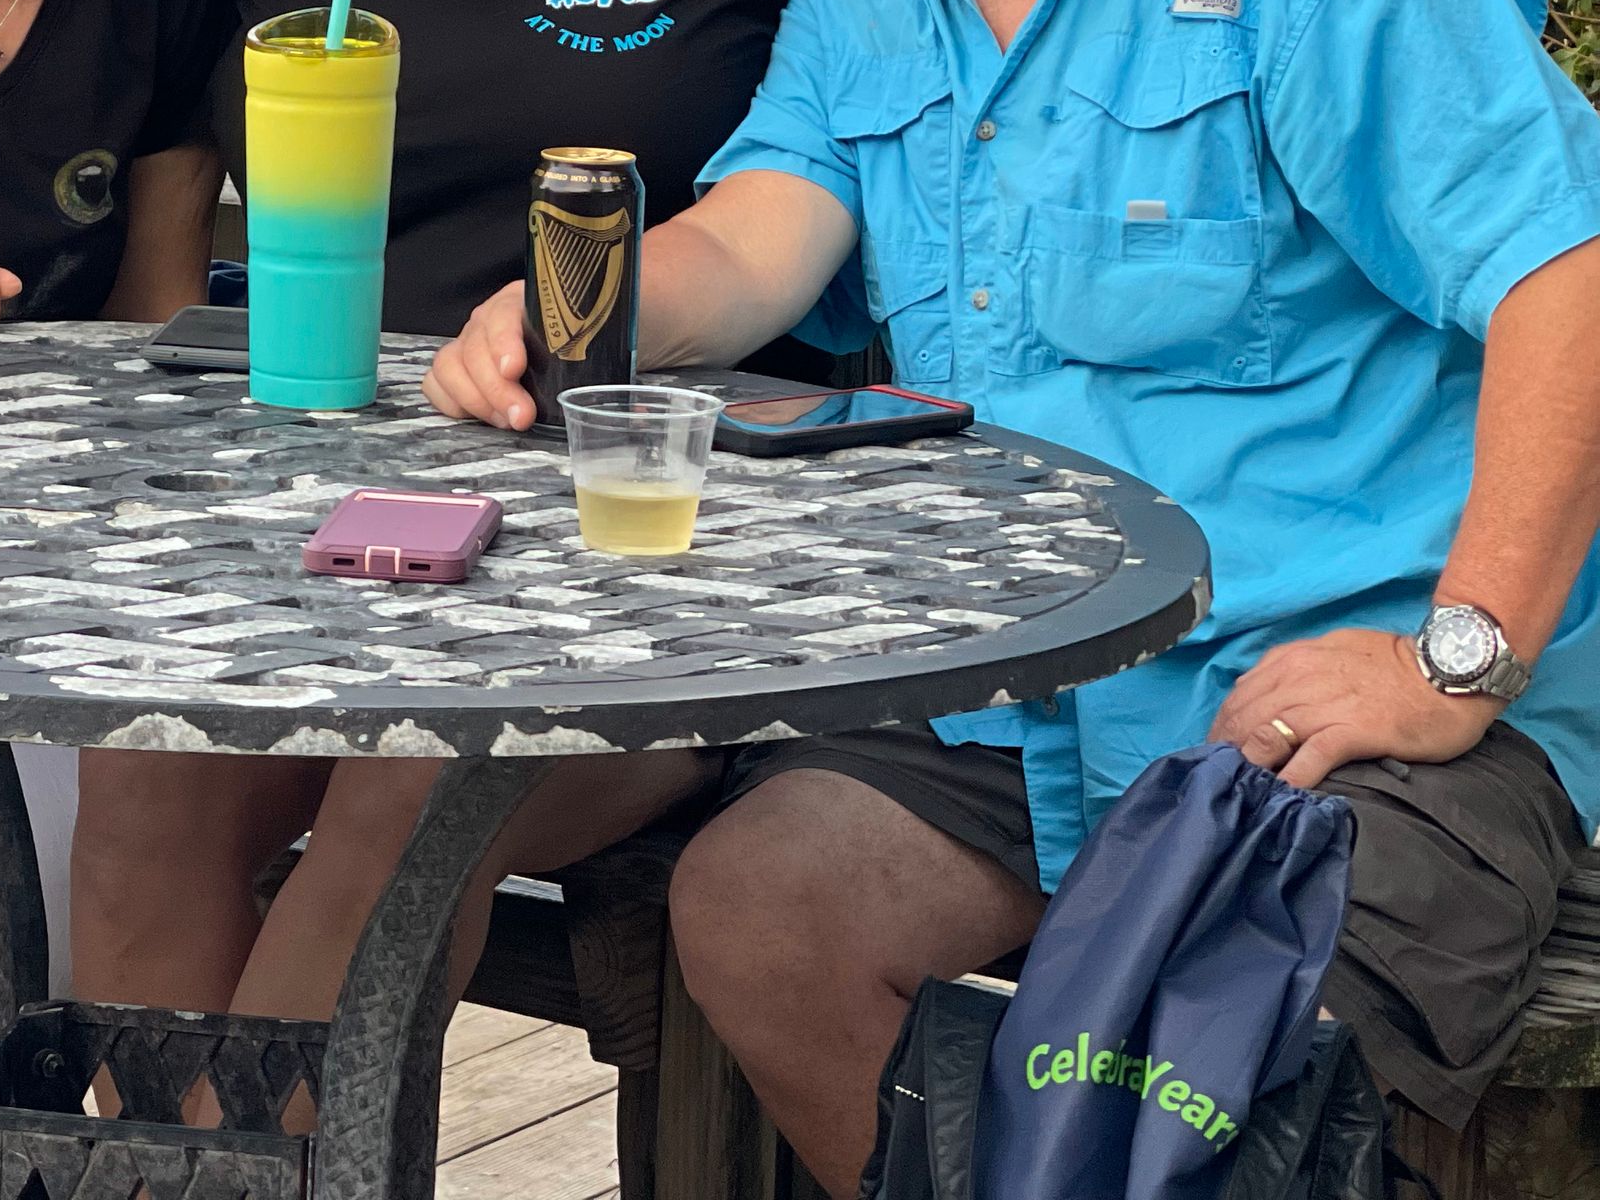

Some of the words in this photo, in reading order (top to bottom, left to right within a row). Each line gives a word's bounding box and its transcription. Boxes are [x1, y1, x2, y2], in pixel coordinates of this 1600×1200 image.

[523, 14, 556, 33] AT
[556, 28, 604, 52] THE
[612, 12, 675, 52] MOON
[545, 307, 561, 338] 1759
